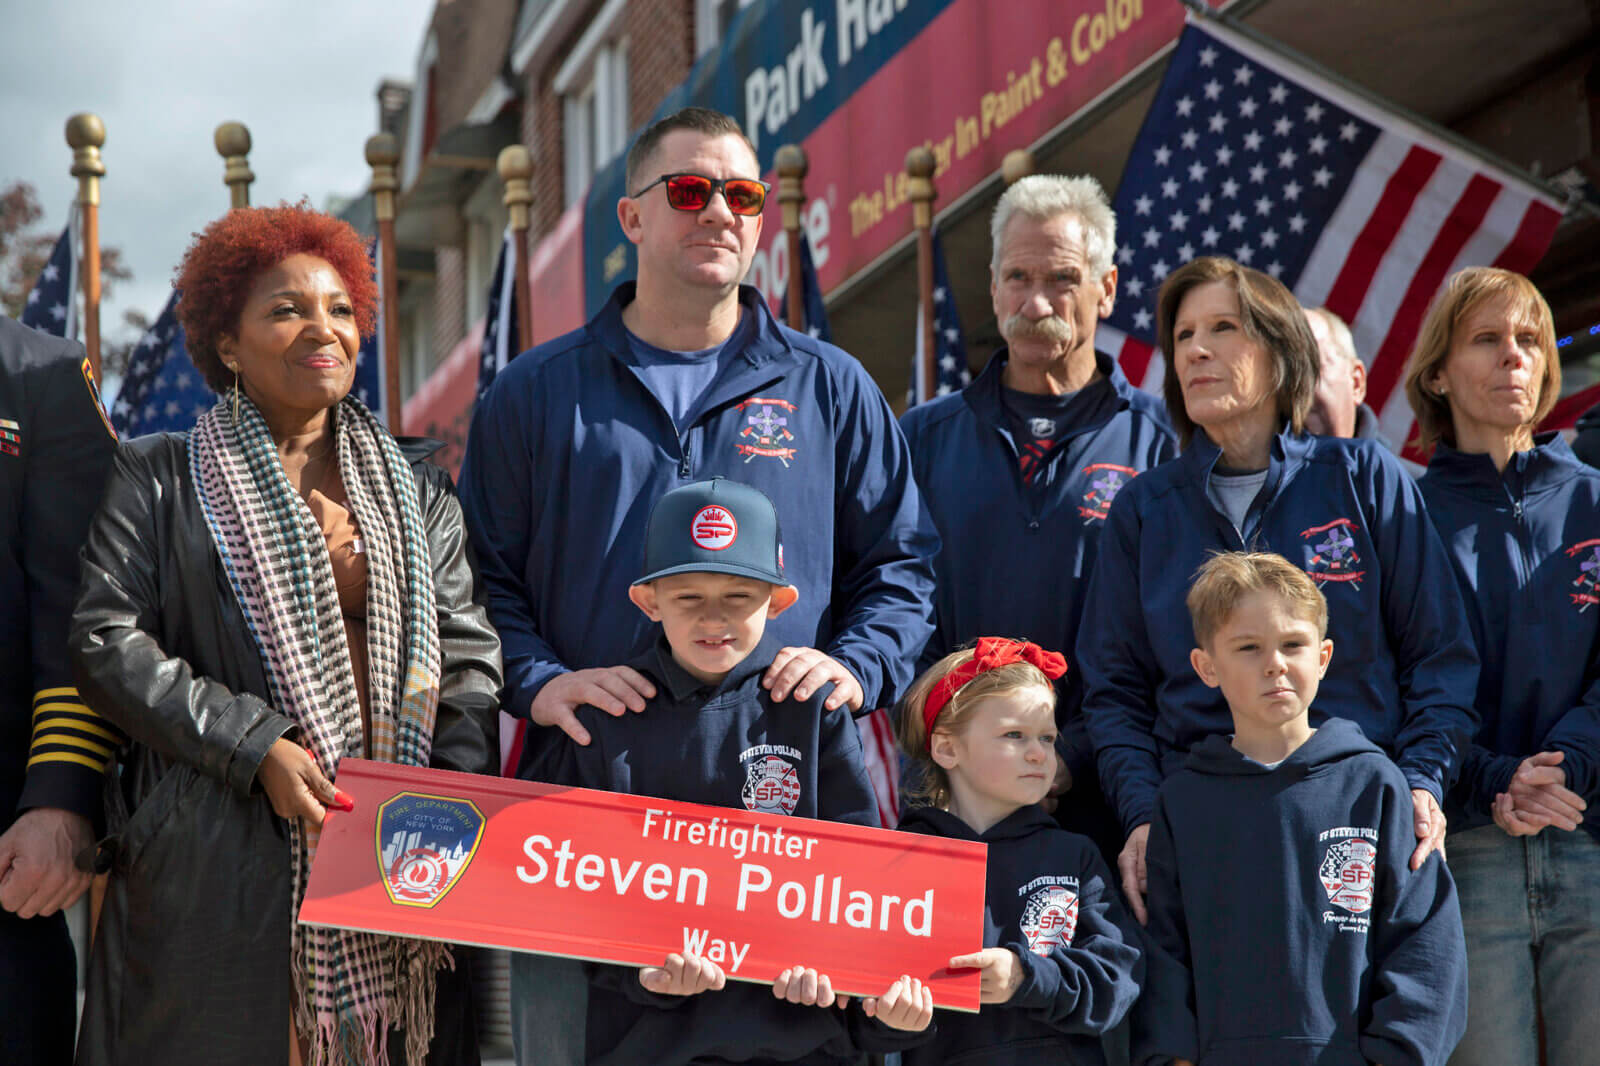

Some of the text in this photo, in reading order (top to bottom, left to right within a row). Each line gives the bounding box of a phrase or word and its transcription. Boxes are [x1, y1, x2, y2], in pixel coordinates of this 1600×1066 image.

[744, 0, 908, 153] Park Ha
[849, 191, 884, 239] The
[884, 139, 955, 213] Leer
[955, 115, 980, 160] In
[980, 56, 1044, 139] Paint
[1046, 36, 1069, 87] &
[742, 197, 830, 301] ooe
[696, 522, 733, 539] SP
[755, 787, 782, 801] SP
[406, 820, 455, 833] NEW YORK
[414, 814, 451, 825] CITY OF
[415, 800, 473, 828] DEPARTMENT
[642, 808, 818, 860] Firefighter
[516, 834, 934, 937] Steven Pollard
[1342, 869, 1370, 884] SP
[1040, 916, 1065, 929] SP
[683, 927, 750, 973] Way
